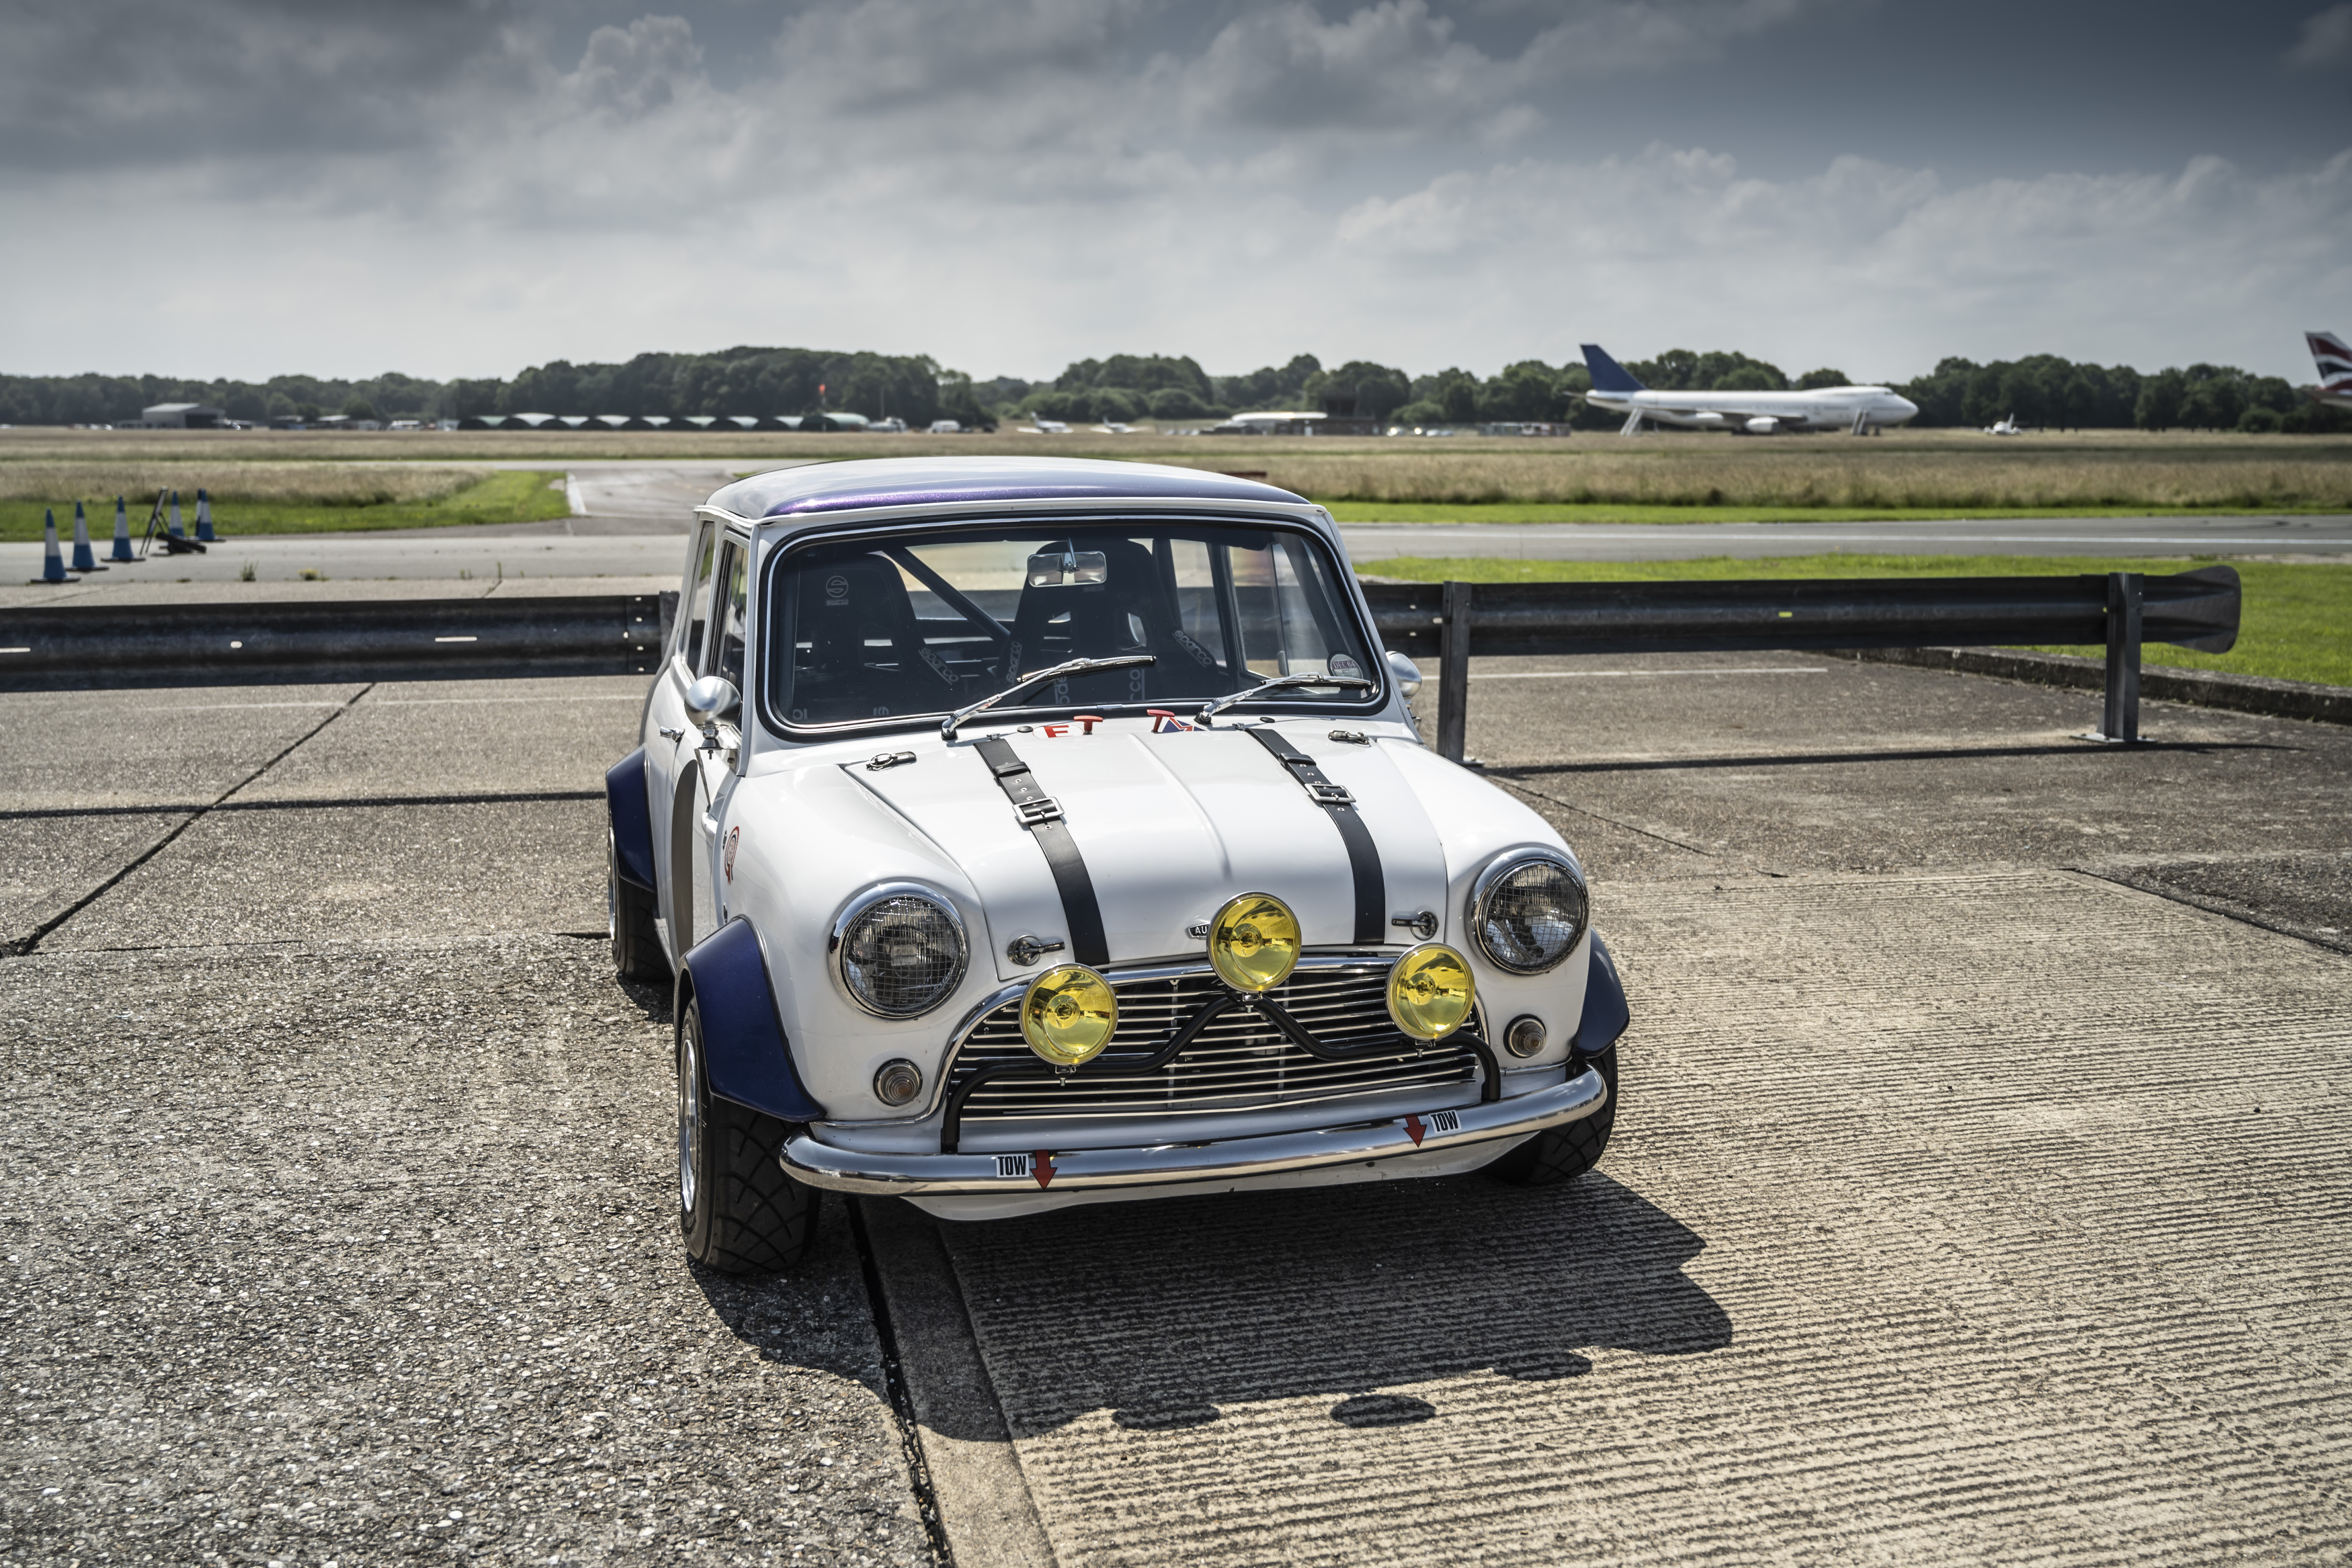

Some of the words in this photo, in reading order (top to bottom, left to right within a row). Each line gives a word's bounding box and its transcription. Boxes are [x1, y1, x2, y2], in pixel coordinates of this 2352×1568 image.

[919, 647, 959, 684] sparco
[1006, 641, 1022, 685] sparco
[1172, 630, 1212, 667] sparco
[1430, 1111, 1458, 1132] TOW
[998, 1155, 1026, 1175] TOW
